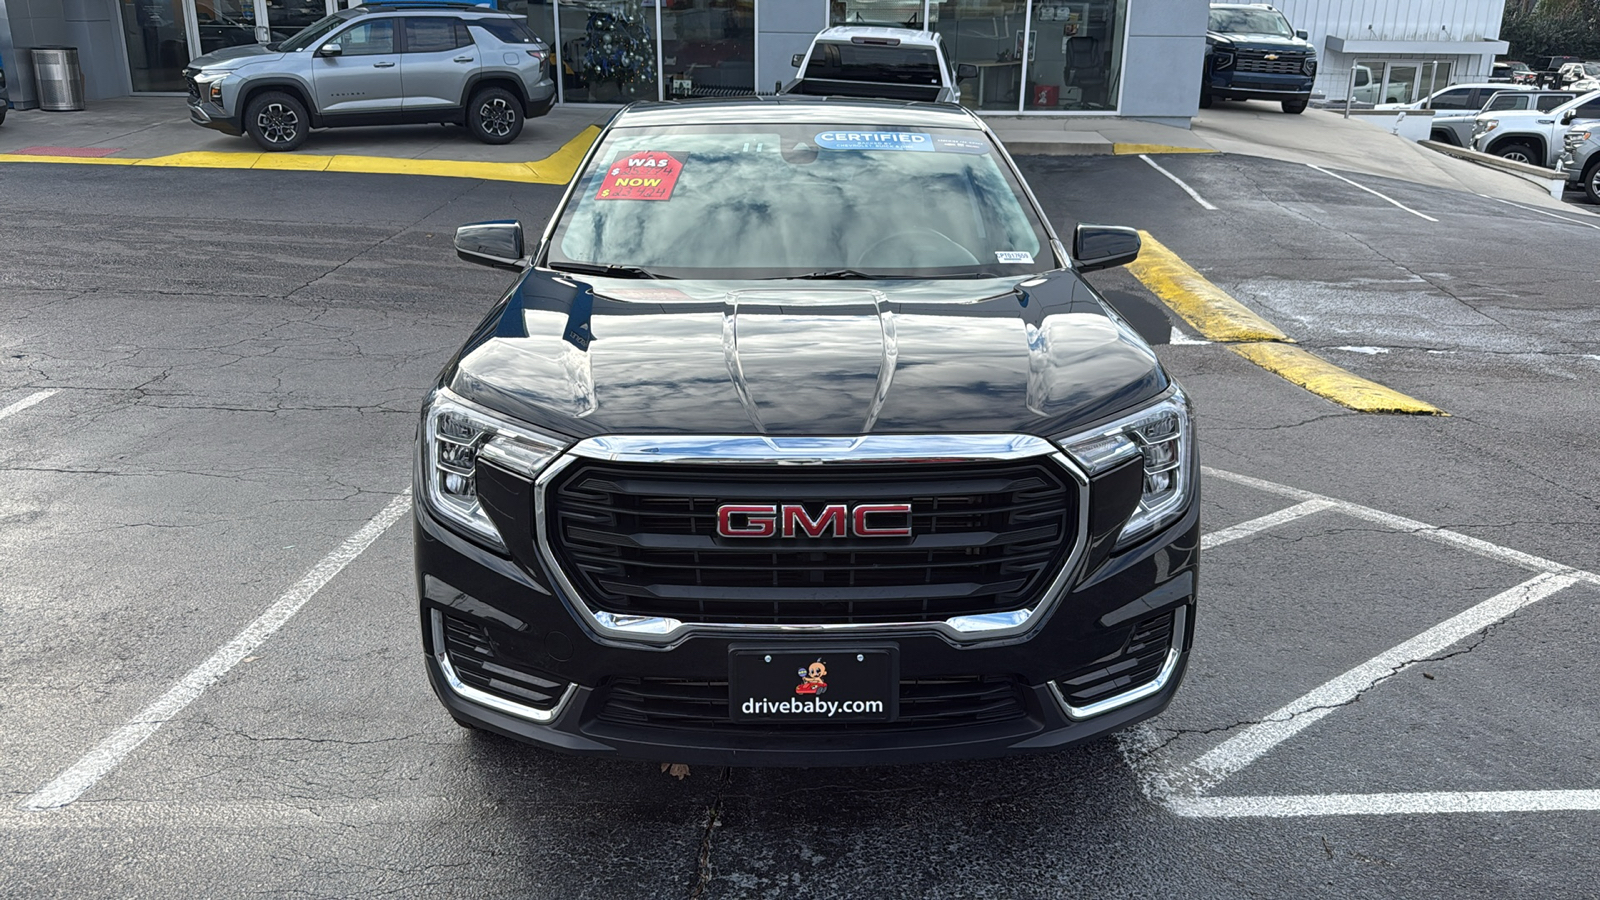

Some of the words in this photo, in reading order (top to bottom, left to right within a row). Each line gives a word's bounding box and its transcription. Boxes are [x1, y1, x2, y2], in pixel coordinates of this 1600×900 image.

[820, 132, 925, 143] CERTIFIED
[628, 158, 669, 167] WAS
[615, 178, 662, 187] NOW
[716, 503, 912, 538] GMC
[742, 697, 883, 717] drivebaby.com
